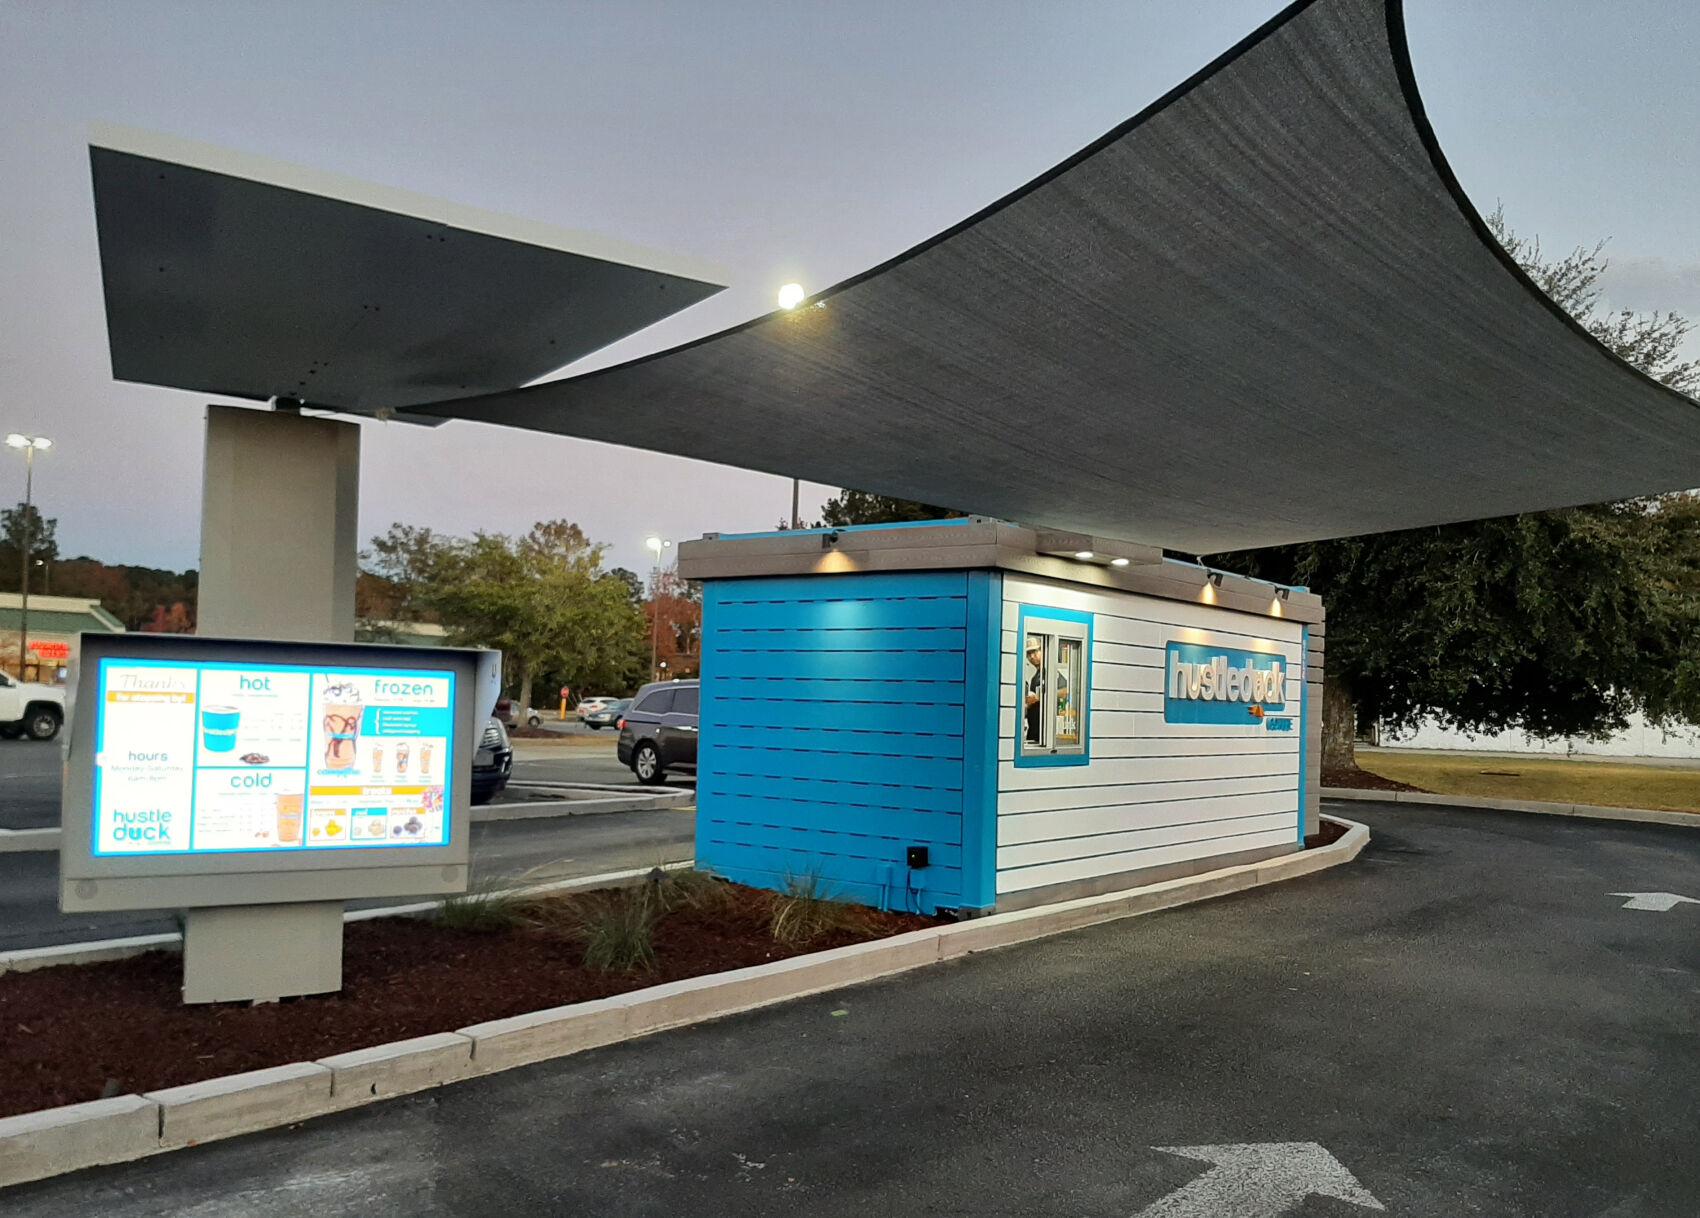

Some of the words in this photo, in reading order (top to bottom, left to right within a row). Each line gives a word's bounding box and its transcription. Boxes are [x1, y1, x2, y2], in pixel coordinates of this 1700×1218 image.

[239, 673, 272, 691] hot
[374, 678, 434, 695] frozen
[127, 750, 169, 761] hours
[230, 771, 273, 788] cold
[112, 808, 173, 823] hustle
[112, 822, 173, 841] duck
